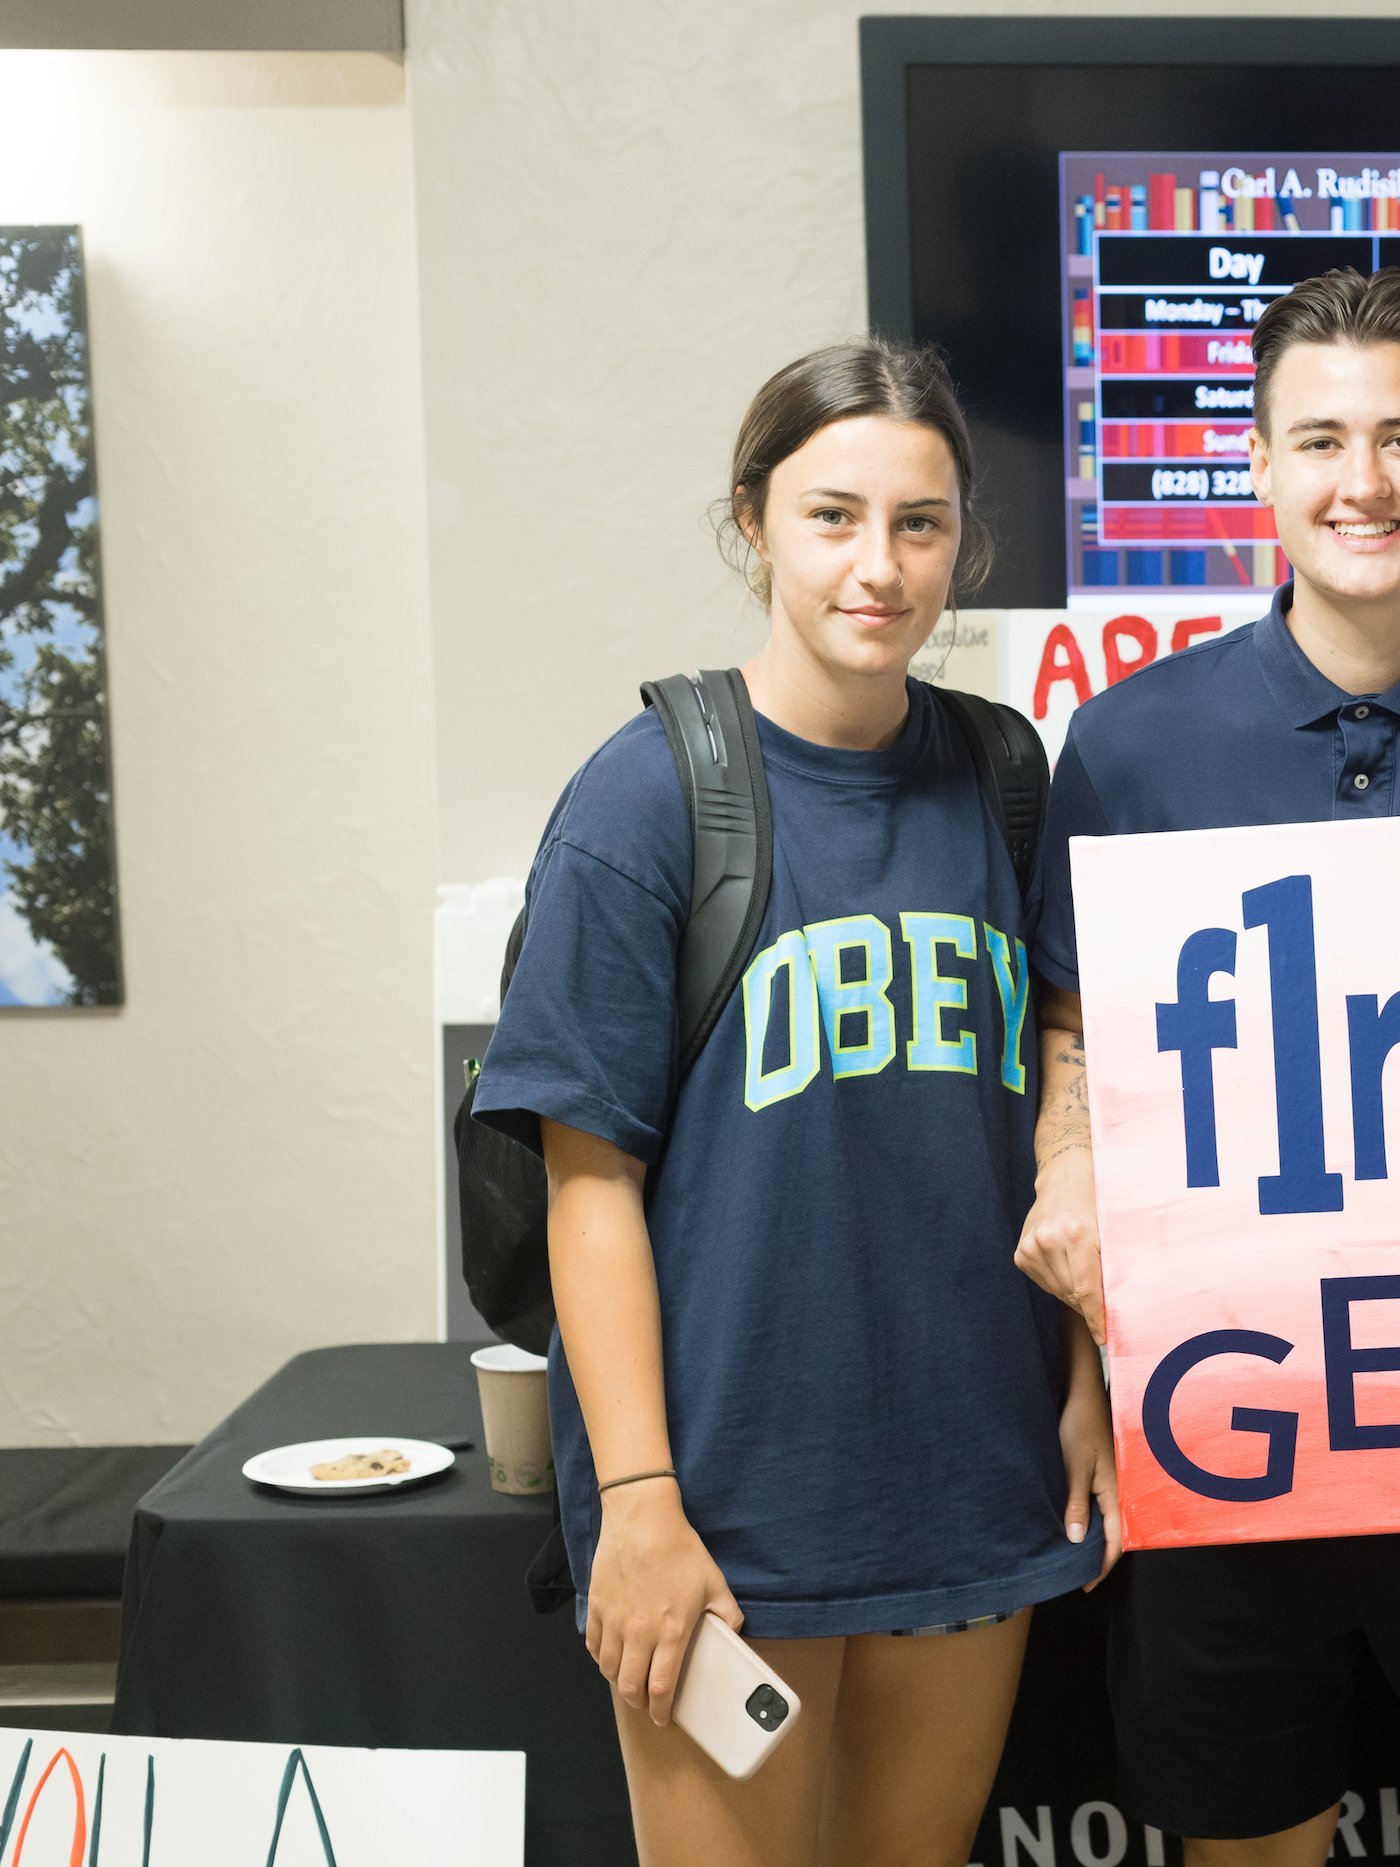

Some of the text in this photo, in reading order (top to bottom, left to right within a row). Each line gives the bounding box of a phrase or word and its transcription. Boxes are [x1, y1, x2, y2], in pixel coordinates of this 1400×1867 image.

[1220, 167, 1276, 199] Carl
[1279, 169, 1313, 199] A.
[1208, 247, 1265, 285] Day
[1145, 298, 1224, 326] Monday
[1152, 469, 1209, 499] (828)
[742, 911, 1030, 1113] OBEY
